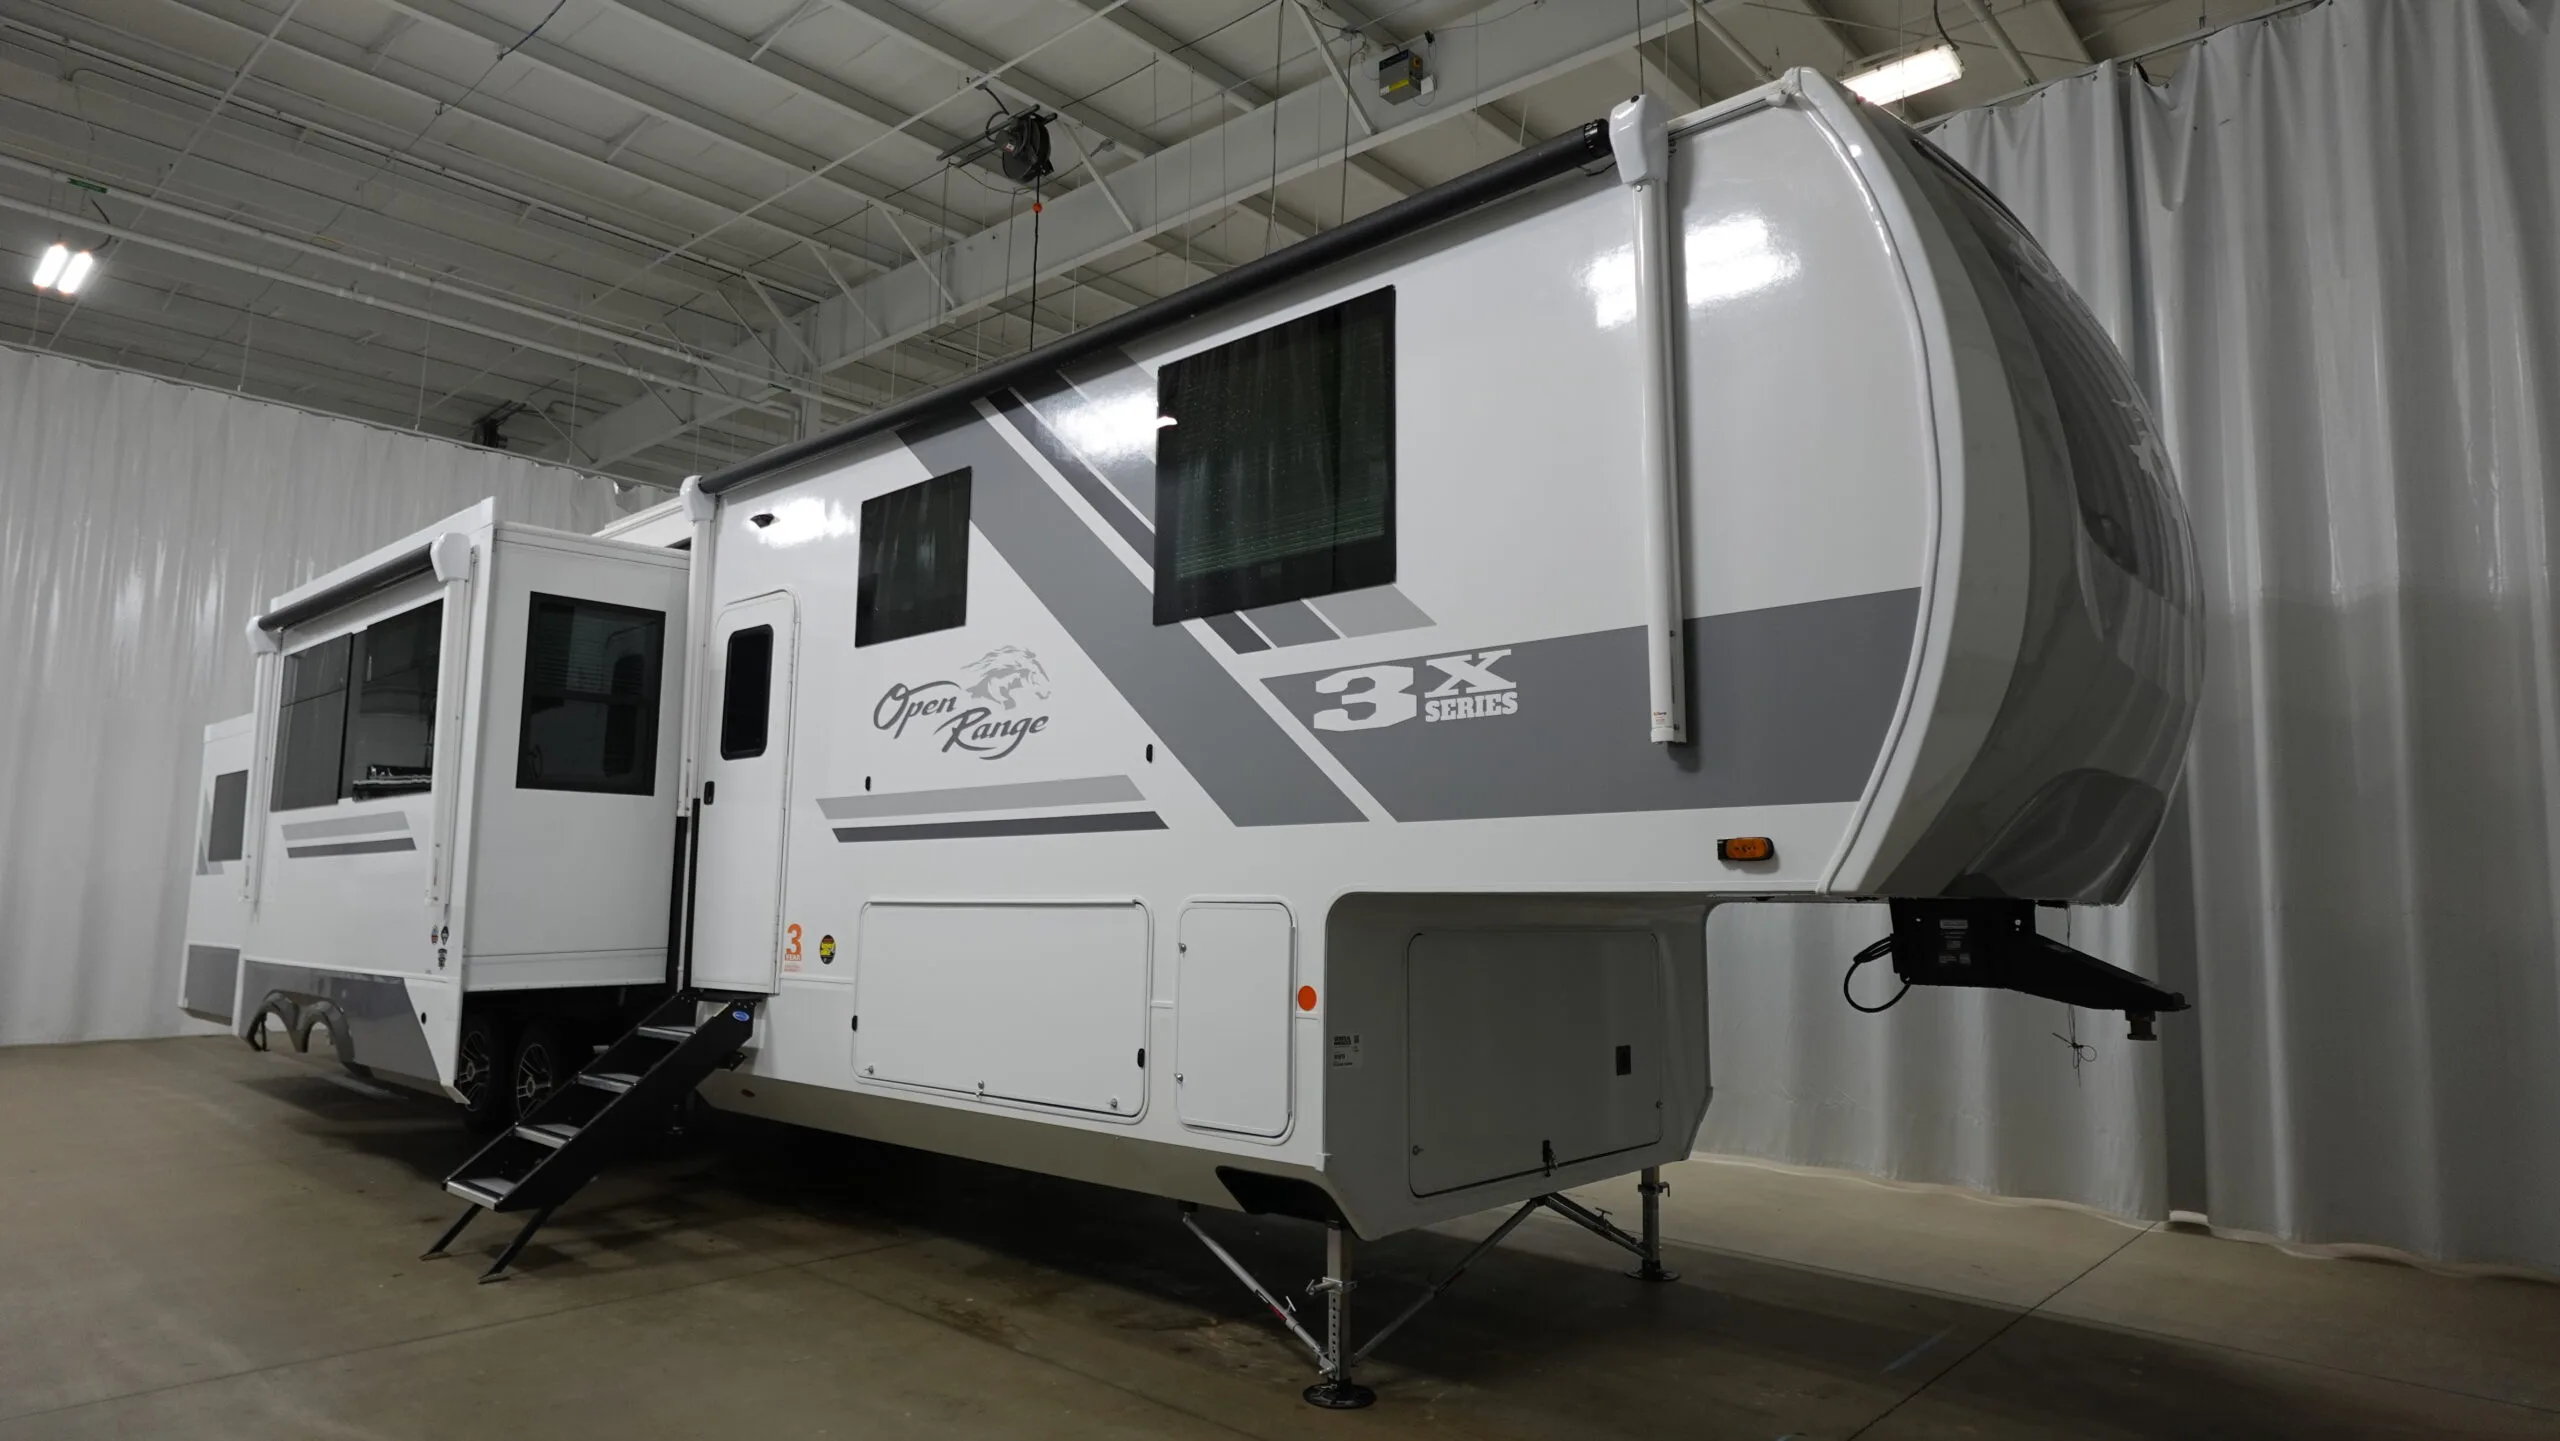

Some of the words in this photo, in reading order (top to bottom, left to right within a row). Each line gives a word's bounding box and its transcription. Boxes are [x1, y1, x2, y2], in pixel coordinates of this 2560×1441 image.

[873, 680, 961, 740] Open
[1424, 691, 1519, 723] SERIES
[933, 706, 1050, 761] Range
[785, 923, 802, 955] 3
